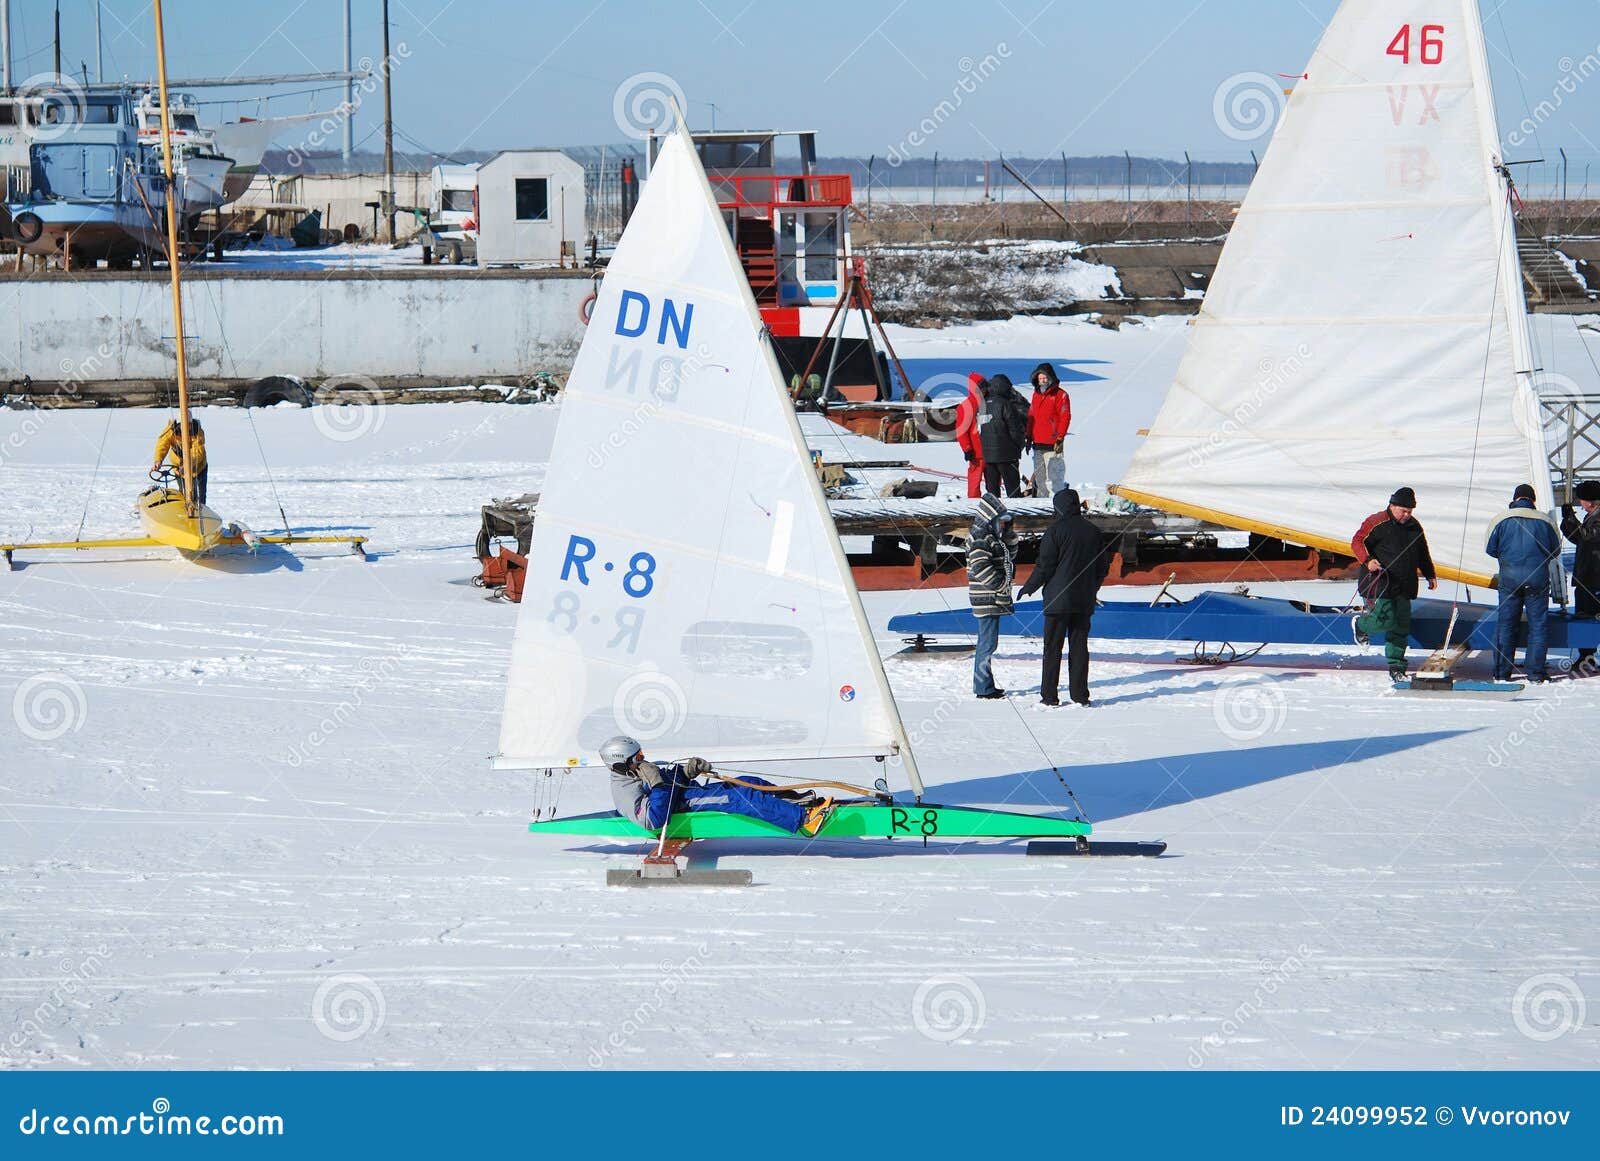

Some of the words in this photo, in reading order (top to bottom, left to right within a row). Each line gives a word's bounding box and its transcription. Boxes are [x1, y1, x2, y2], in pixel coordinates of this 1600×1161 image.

[1386, 24, 1445, 64] 46
[615, 289, 694, 349] DN
[891, 808, 938, 836] R-8
